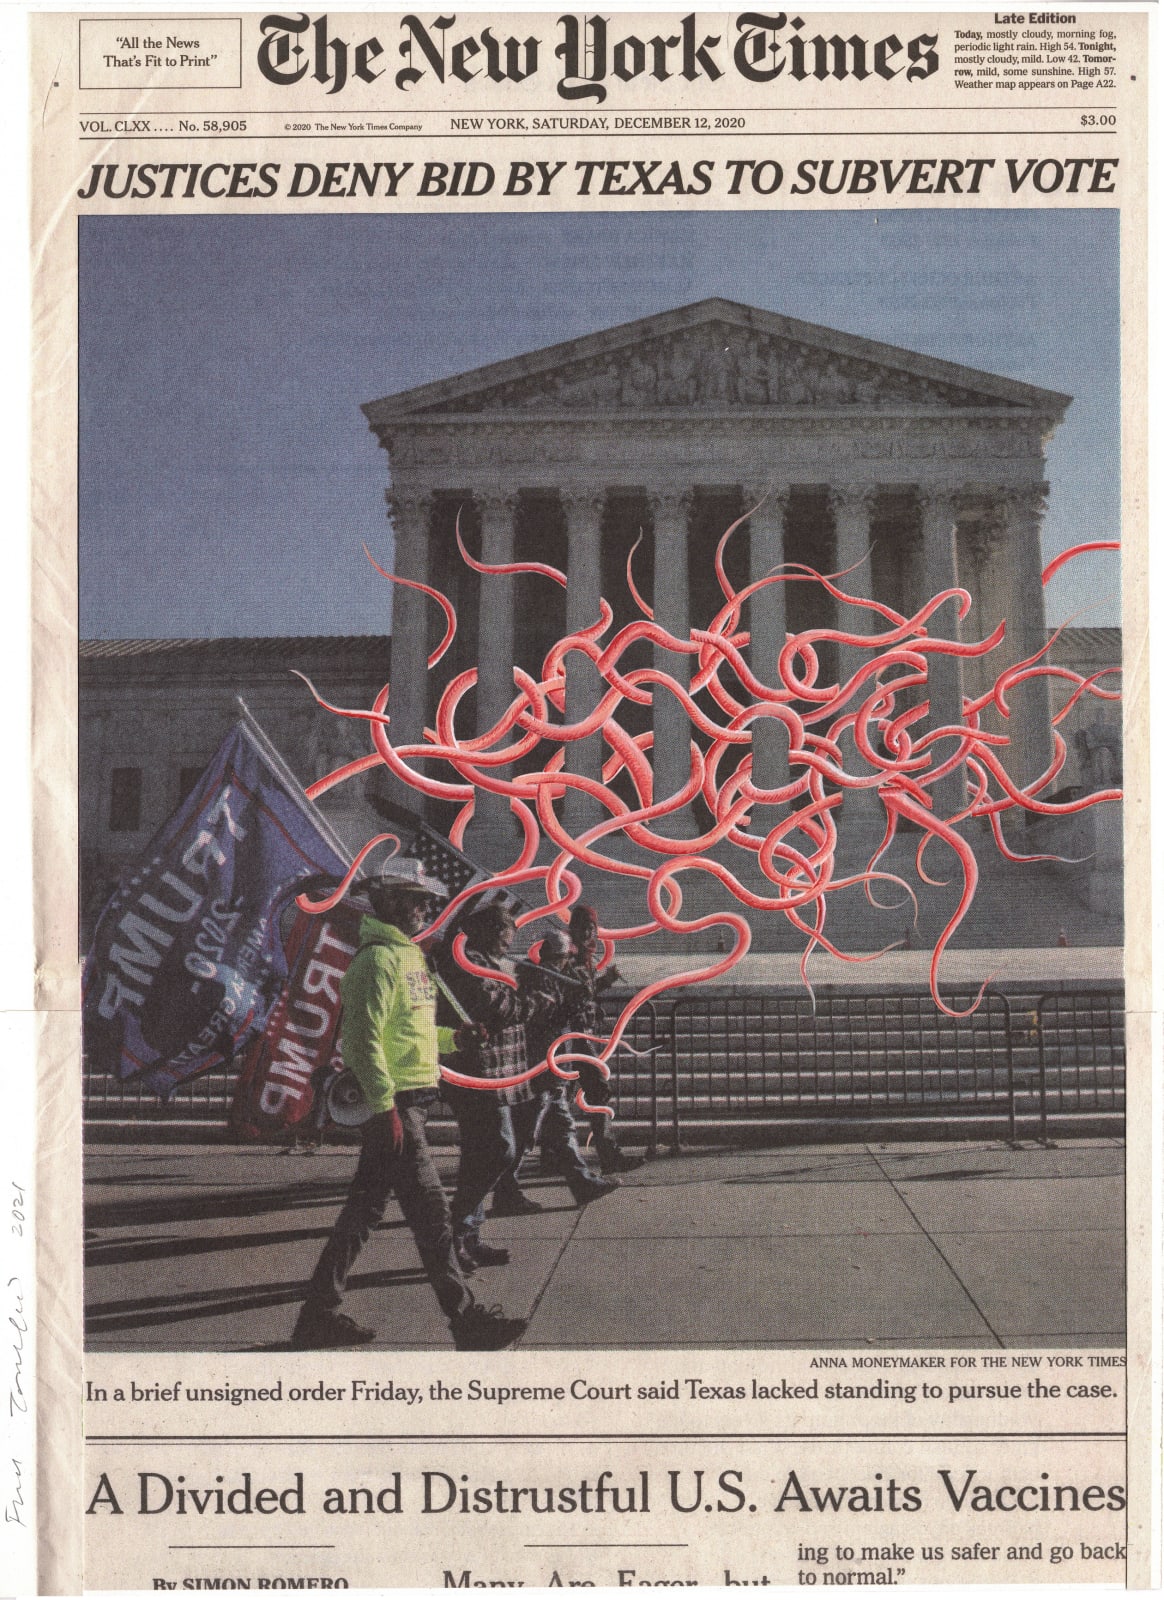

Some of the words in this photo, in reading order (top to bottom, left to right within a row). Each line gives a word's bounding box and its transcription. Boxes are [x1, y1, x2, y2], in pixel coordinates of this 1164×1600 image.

[994, 12, 1025, 25] Late
[1028, 12, 1077, 24] Edition
[954, 29, 983, 41] Today,
[986, 29, 1019, 41] mostly
[1021, 29, 1054, 41] cloudy,
[1056, 31, 1096, 41] morning
[1099, 29, 1117, 40] fog,
[142, 35, 164, 50] the
[165, 35, 201, 50] News
[954, 42, 992, 54] periodic
[992, 42, 1015, 53] light
[1016, 42, 1038, 51] rain.
[1039, 41, 1062, 53] High
[1063, 42, 1077, 51] 54.
[1077, 41, 1117, 53] Tonight,
[145, 54, 162, 67] Fit
[165, 57, 177, 67] to
[258, 13, 385, 94] The
[396, 15, 542, 91] New
[555, 13, 724, 104] York
[734, 13, 938, 82] Times
[954, 54, 986, 66] mostly
[986, 54, 1020, 66] cloudy,
[1021, 54, 1045, 64] mild.
[1046, 54, 1066, 64] Low
[1067, 54, 1081, 63] 42.
[1082, 54, 1117, 63] Tomor-
[954, 69, 974, 78] row,
[976, 66, 1000, 78] mild,
[1003, 68, 1028, 76] some
[1031, 66, 1076, 76] sunshine.
[1077, 66, 1102, 78] High
[1103, 66, 1117, 77] 57.
[954, 79, 994, 89] Weather
[995, 81, 1017, 91] map
[1018, 81, 1056, 91] appears
[1057, 81, 1069, 89] on
[1070, 79, 1094, 90] Page
[1095, 79, 1117, 88] A22.
[78, 120, 113, 133] VOL.
[113, 120, 151, 133] CLXX
[178, 119, 201, 132] No.
[202, 119, 248, 133] 58,905
[449, 117, 484, 130] NEW
[485, 117, 530, 132] YORK,
[532, 117, 609, 131] SATURDAY,
[614, 117, 692, 129] DECEMBER
[694, 117, 711, 130] 12,
[714, 117, 746, 128] 2020
[1080, 114, 1117, 126] $3.00
[292, 123, 312, 131] 2020
[314, 123, 330, 131] The
[330, 123, 347, 131] New
[348, 122, 365, 131] York
[367, 122, 388, 131] Times
[388, 122, 423, 132] Company
[78, 163, 280, 198] JUSTICES
[287, 163, 413, 197] DENY
[417, 162, 495, 196] BID
[503, 162, 567, 195] BY
[575, 161, 714, 195] TEXAS
[726, 160, 783, 194] TO
[791, 159, 995, 194] SUBVERT
[1005, 159, 1119, 193] VOTE
[809, 1357, 848, 1368] ANNA
[852, 1356, 946, 1368] MONEYMAKER
[950, 1356, 977, 1368] FOR
[980, 1356, 1008, 1368] THE
[1011, 1356, 1043, 1368] NEW
[1046, 1356, 1084, 1368] YORK
[1087, 1356, 1128, 1368] TIMES
[87, 1382, 107, 1401] In
[113, 1388, 126, 1402] a
[131, 1382, 181, 1401] brief
[186, 1381, 282, 1405] unsigned
[289, 1381, 345, 1400] order
[352, 1381, 422, 1405] Friday,
[430, 1381, 462, 1400] the
[468, 1380, 564, 1404] Supreme
[571, 1380, 631, 1399] Court
[638, 1380, 679, 1399] said
[685, 1379, 745, 1399] Texas
[752, 1379, 818, 1399] lacked
[825, 1379, 917, 1403] standing
[923, 1383, 942, 1398] to
[949, 1386, 1021, 1403] pursue
[1028, 1379, 1060, 1398] the
[1066, 1385, 1118, 1398] case.
[86, 1473, 123, 1514] A
[138, 1473, 305, 1514] Divided
[324, 1472, 403, 1513] and
[422, 1471, 650, 1513] Distrustful
[668, 1470, 756, 1512] U.S.
[775, 1471, 921, 1512] Awaits
[938, 1470, 1126, 1511] Vaccines
[798, 1544, 828, 1563] ing
[836, 1546, 854, 1560] to
[862, 1543, 914, 1560] make
[921, 1546, 944, 1561] us
[952, 1543, 1000, 1560] safer
[1007, 1543, 1041, 1559] and
[1050, 1547, 1073, 1563] go
[1081, 1543, 1126, 1559] back
[182, 1578, 251, 1589] SIMON
[799, 1569, 815, 1585] to
